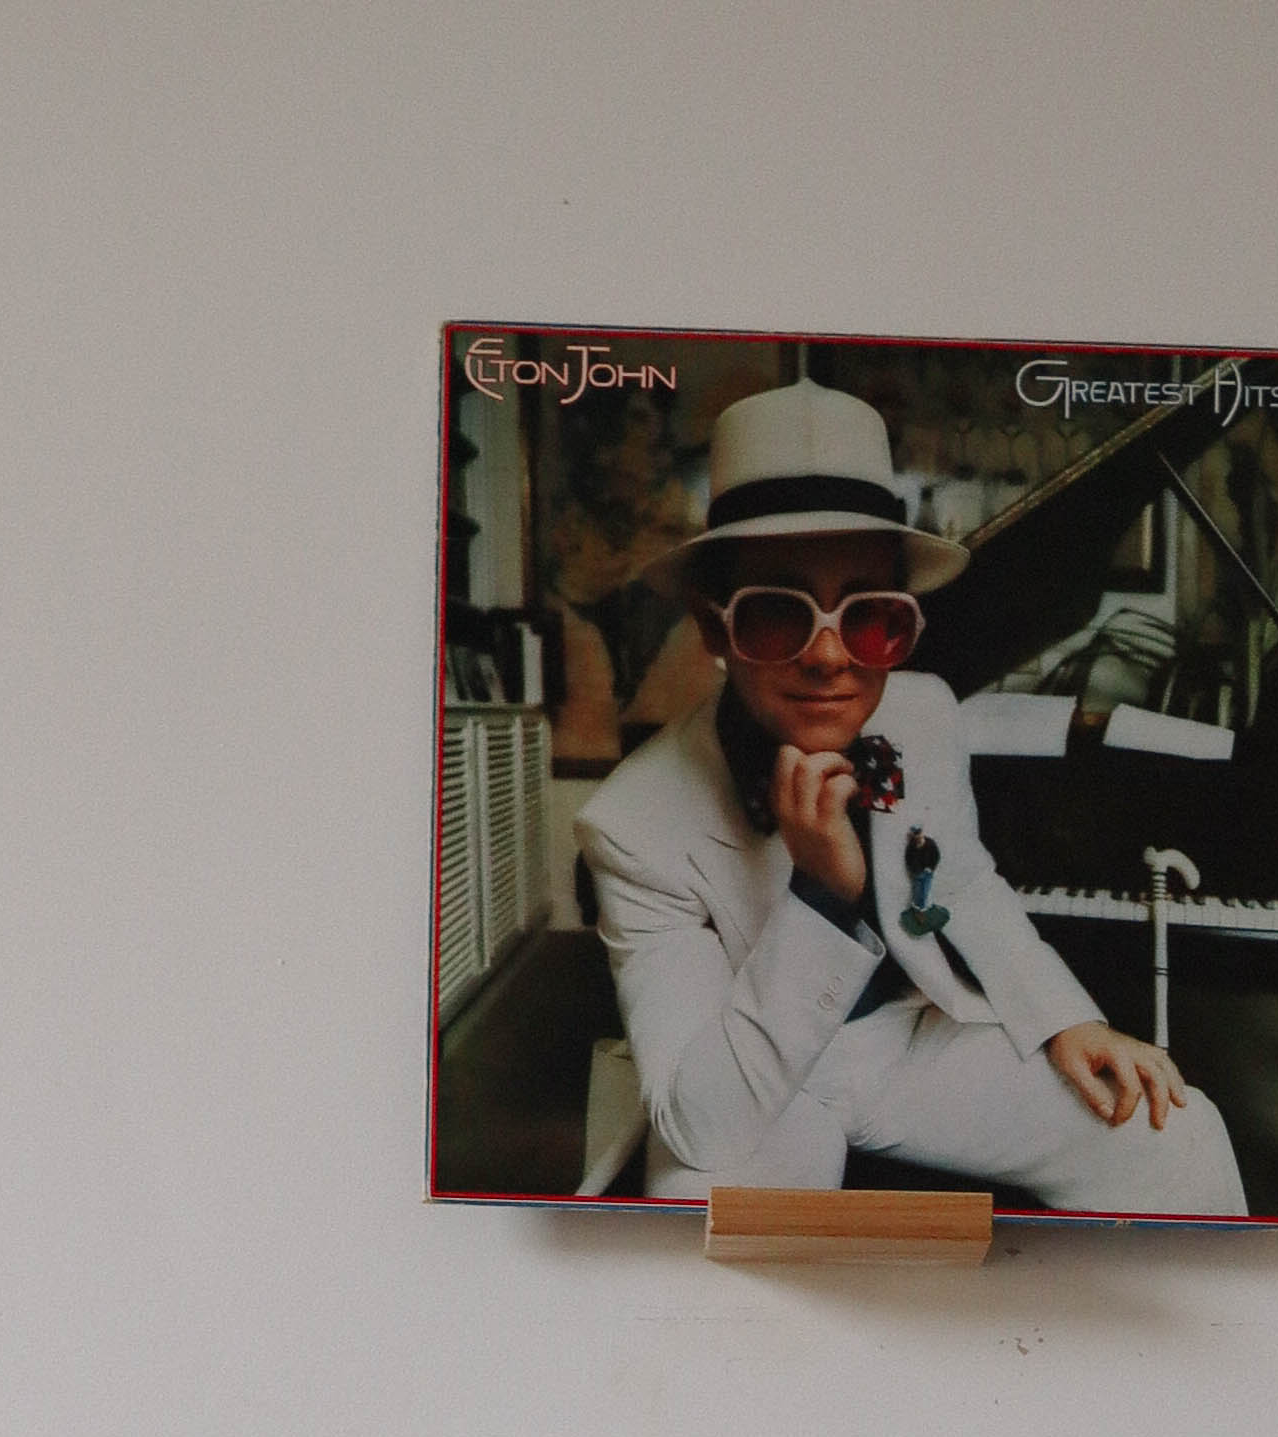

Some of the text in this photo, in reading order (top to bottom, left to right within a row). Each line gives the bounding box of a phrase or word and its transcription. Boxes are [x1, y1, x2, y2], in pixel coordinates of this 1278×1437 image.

[465, 338, 676, 404] ELTON JOHN
[1016, 360, 1203, 418] GREATEST
